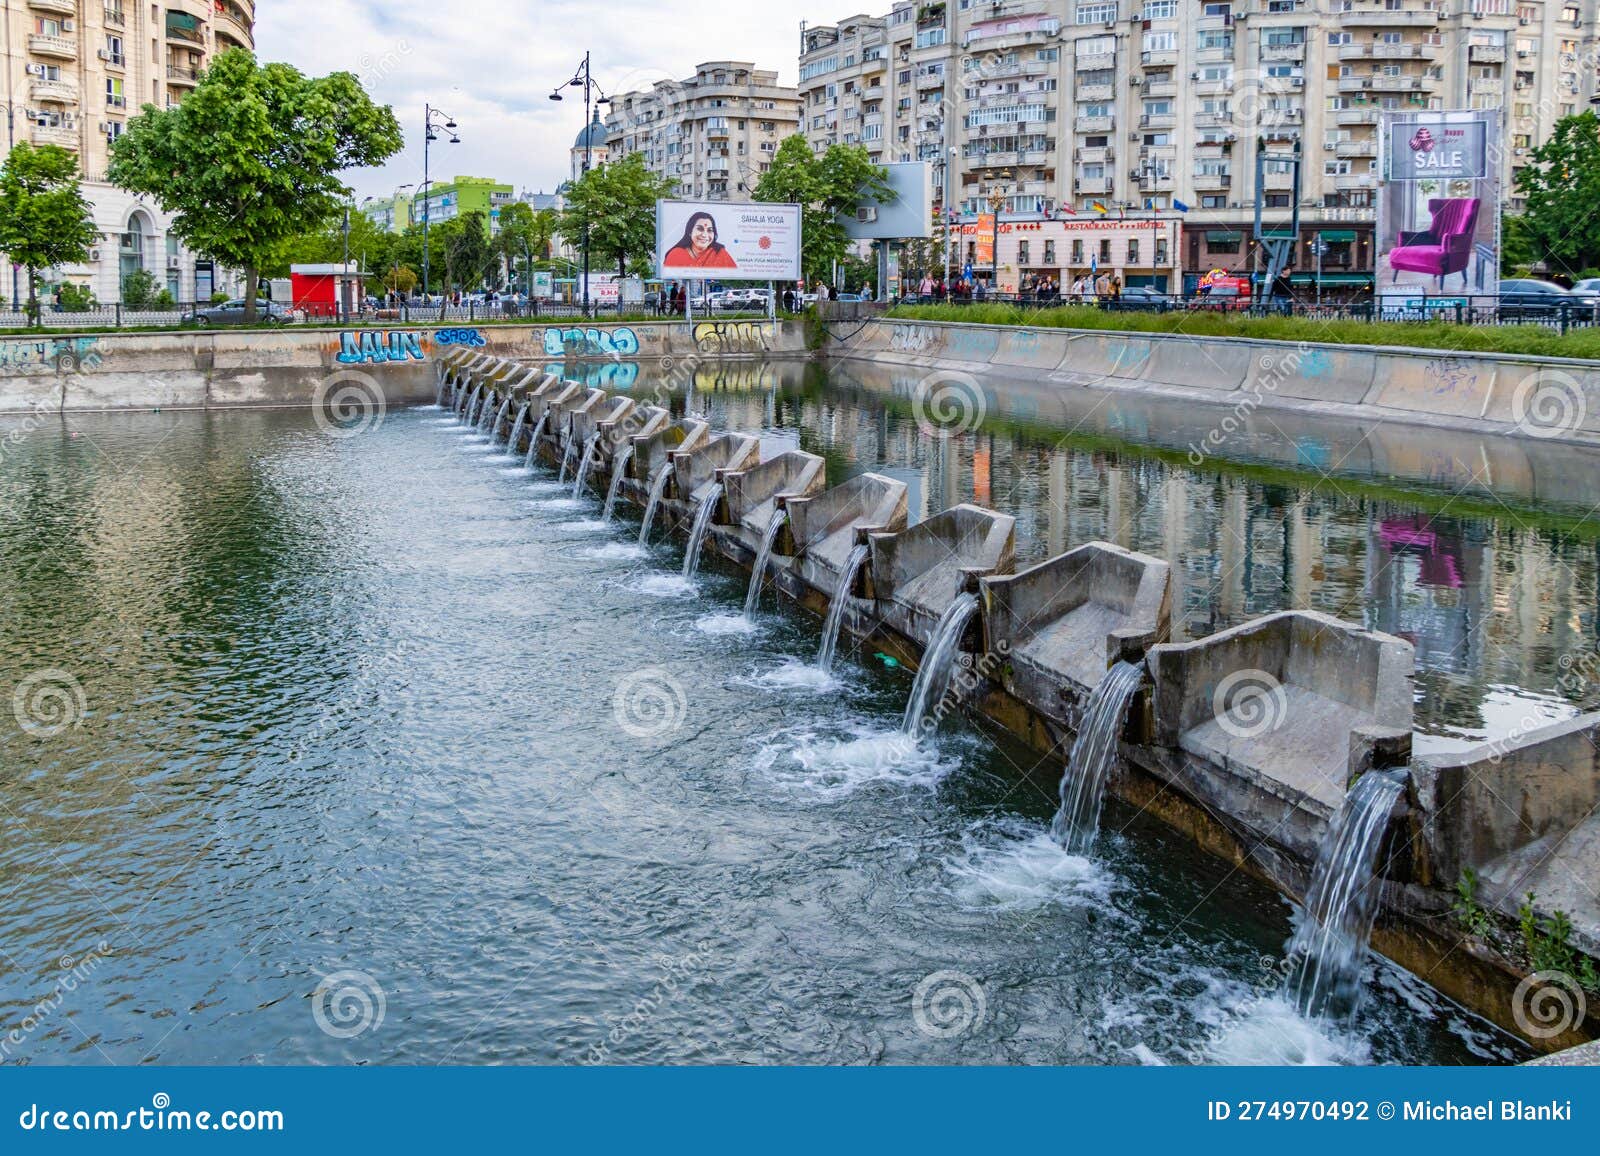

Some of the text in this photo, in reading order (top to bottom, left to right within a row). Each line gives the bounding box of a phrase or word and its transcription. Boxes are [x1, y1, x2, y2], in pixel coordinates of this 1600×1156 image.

[1415, 151, 1462, 168] SALE
[741, 215, 784, 224] SAHAJA YOGA
[1064, 222, 1166, 231] RESTAURANT HOTEL
